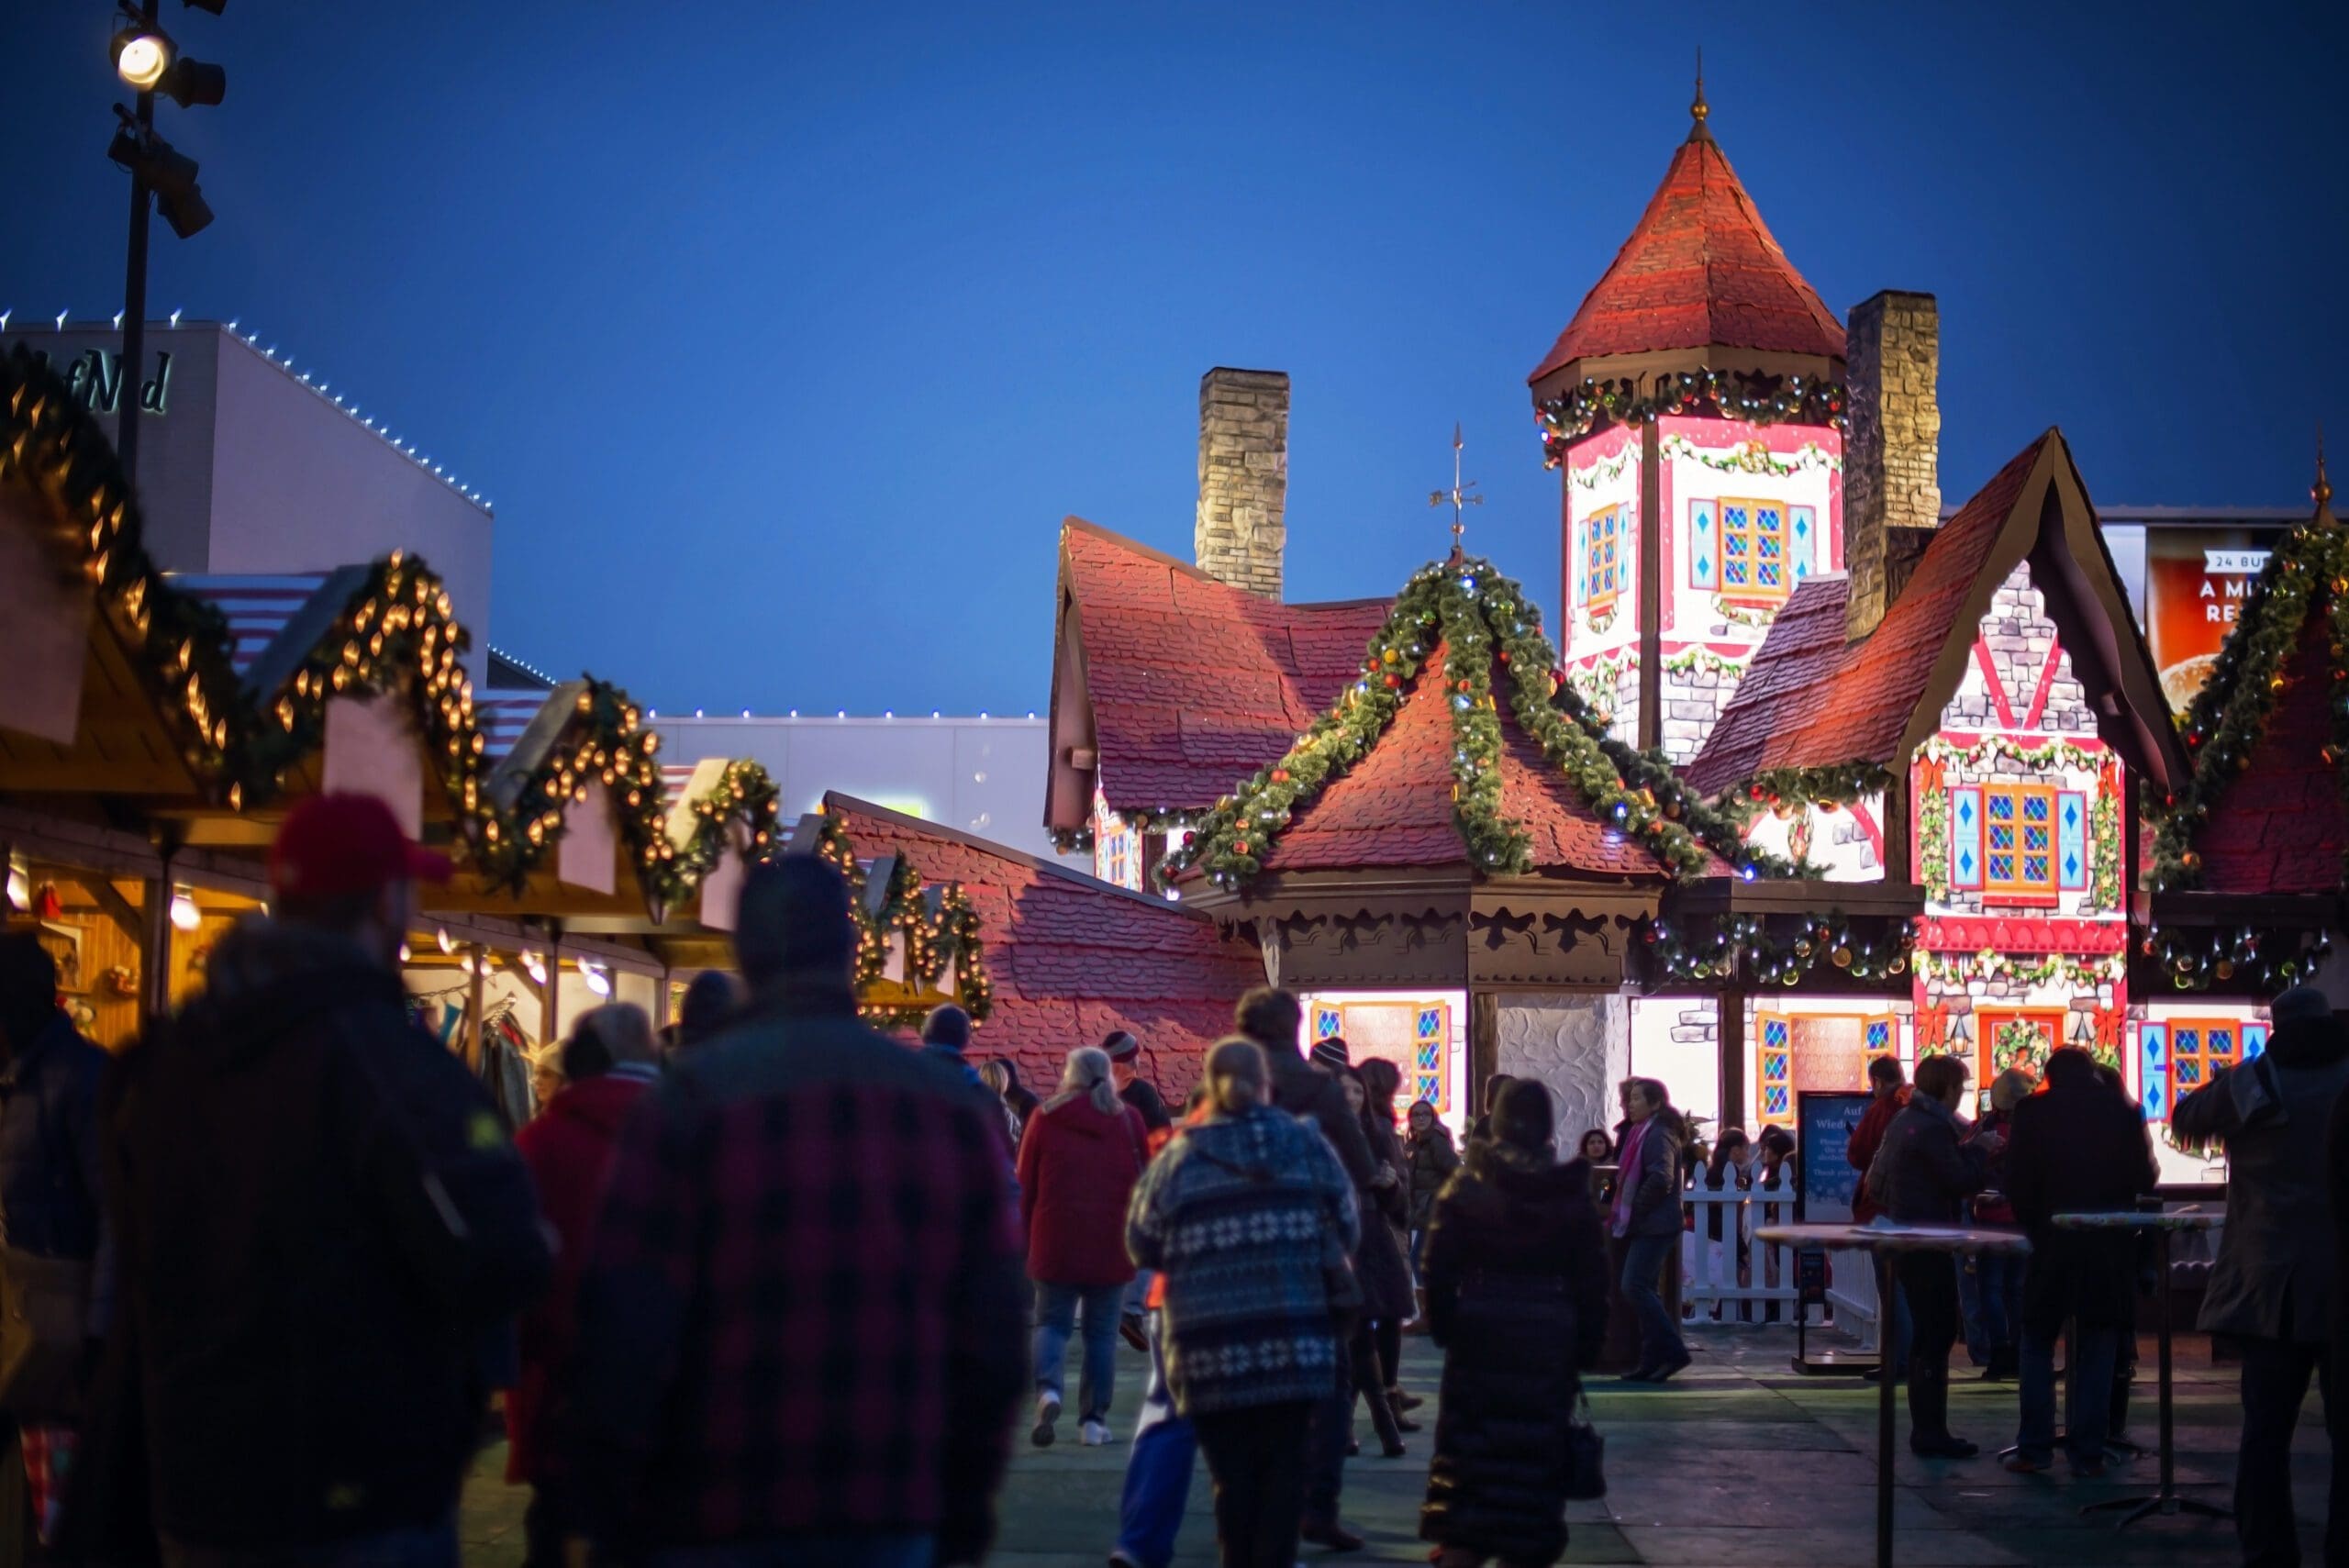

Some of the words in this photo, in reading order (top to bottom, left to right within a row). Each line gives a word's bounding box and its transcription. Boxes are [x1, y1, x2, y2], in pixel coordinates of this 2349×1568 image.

[83, 349, 172, 413] Nd
[2216, 556, 2232, 567] 24
[2241, 556, 2262, 567] BU
[2199, 580, 2216, 598] A
[2225, 580, 2253, 598] MI
[2206, 604, 2236, 623] RE
[1843, 1106, 1863, 1116] Auf
